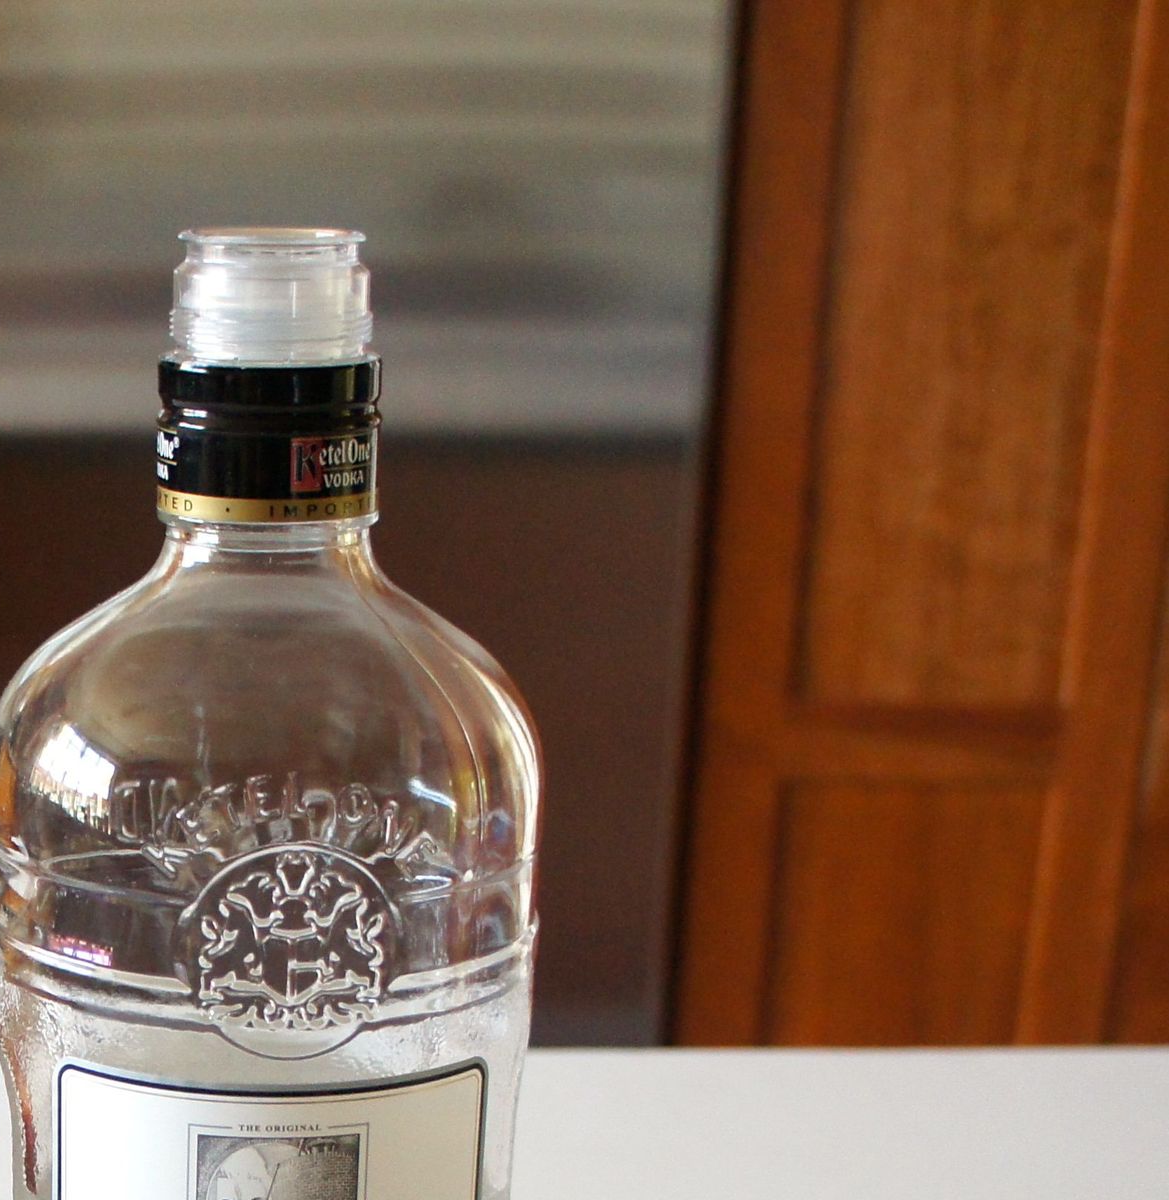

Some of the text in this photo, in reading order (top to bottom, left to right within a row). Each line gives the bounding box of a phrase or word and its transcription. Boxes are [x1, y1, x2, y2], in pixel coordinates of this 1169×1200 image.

[323, 470, 364, 488] VODKA
[158, 494, 193, 511] TED
[238, 1124, 321, 1132] THE ORIGINAL
